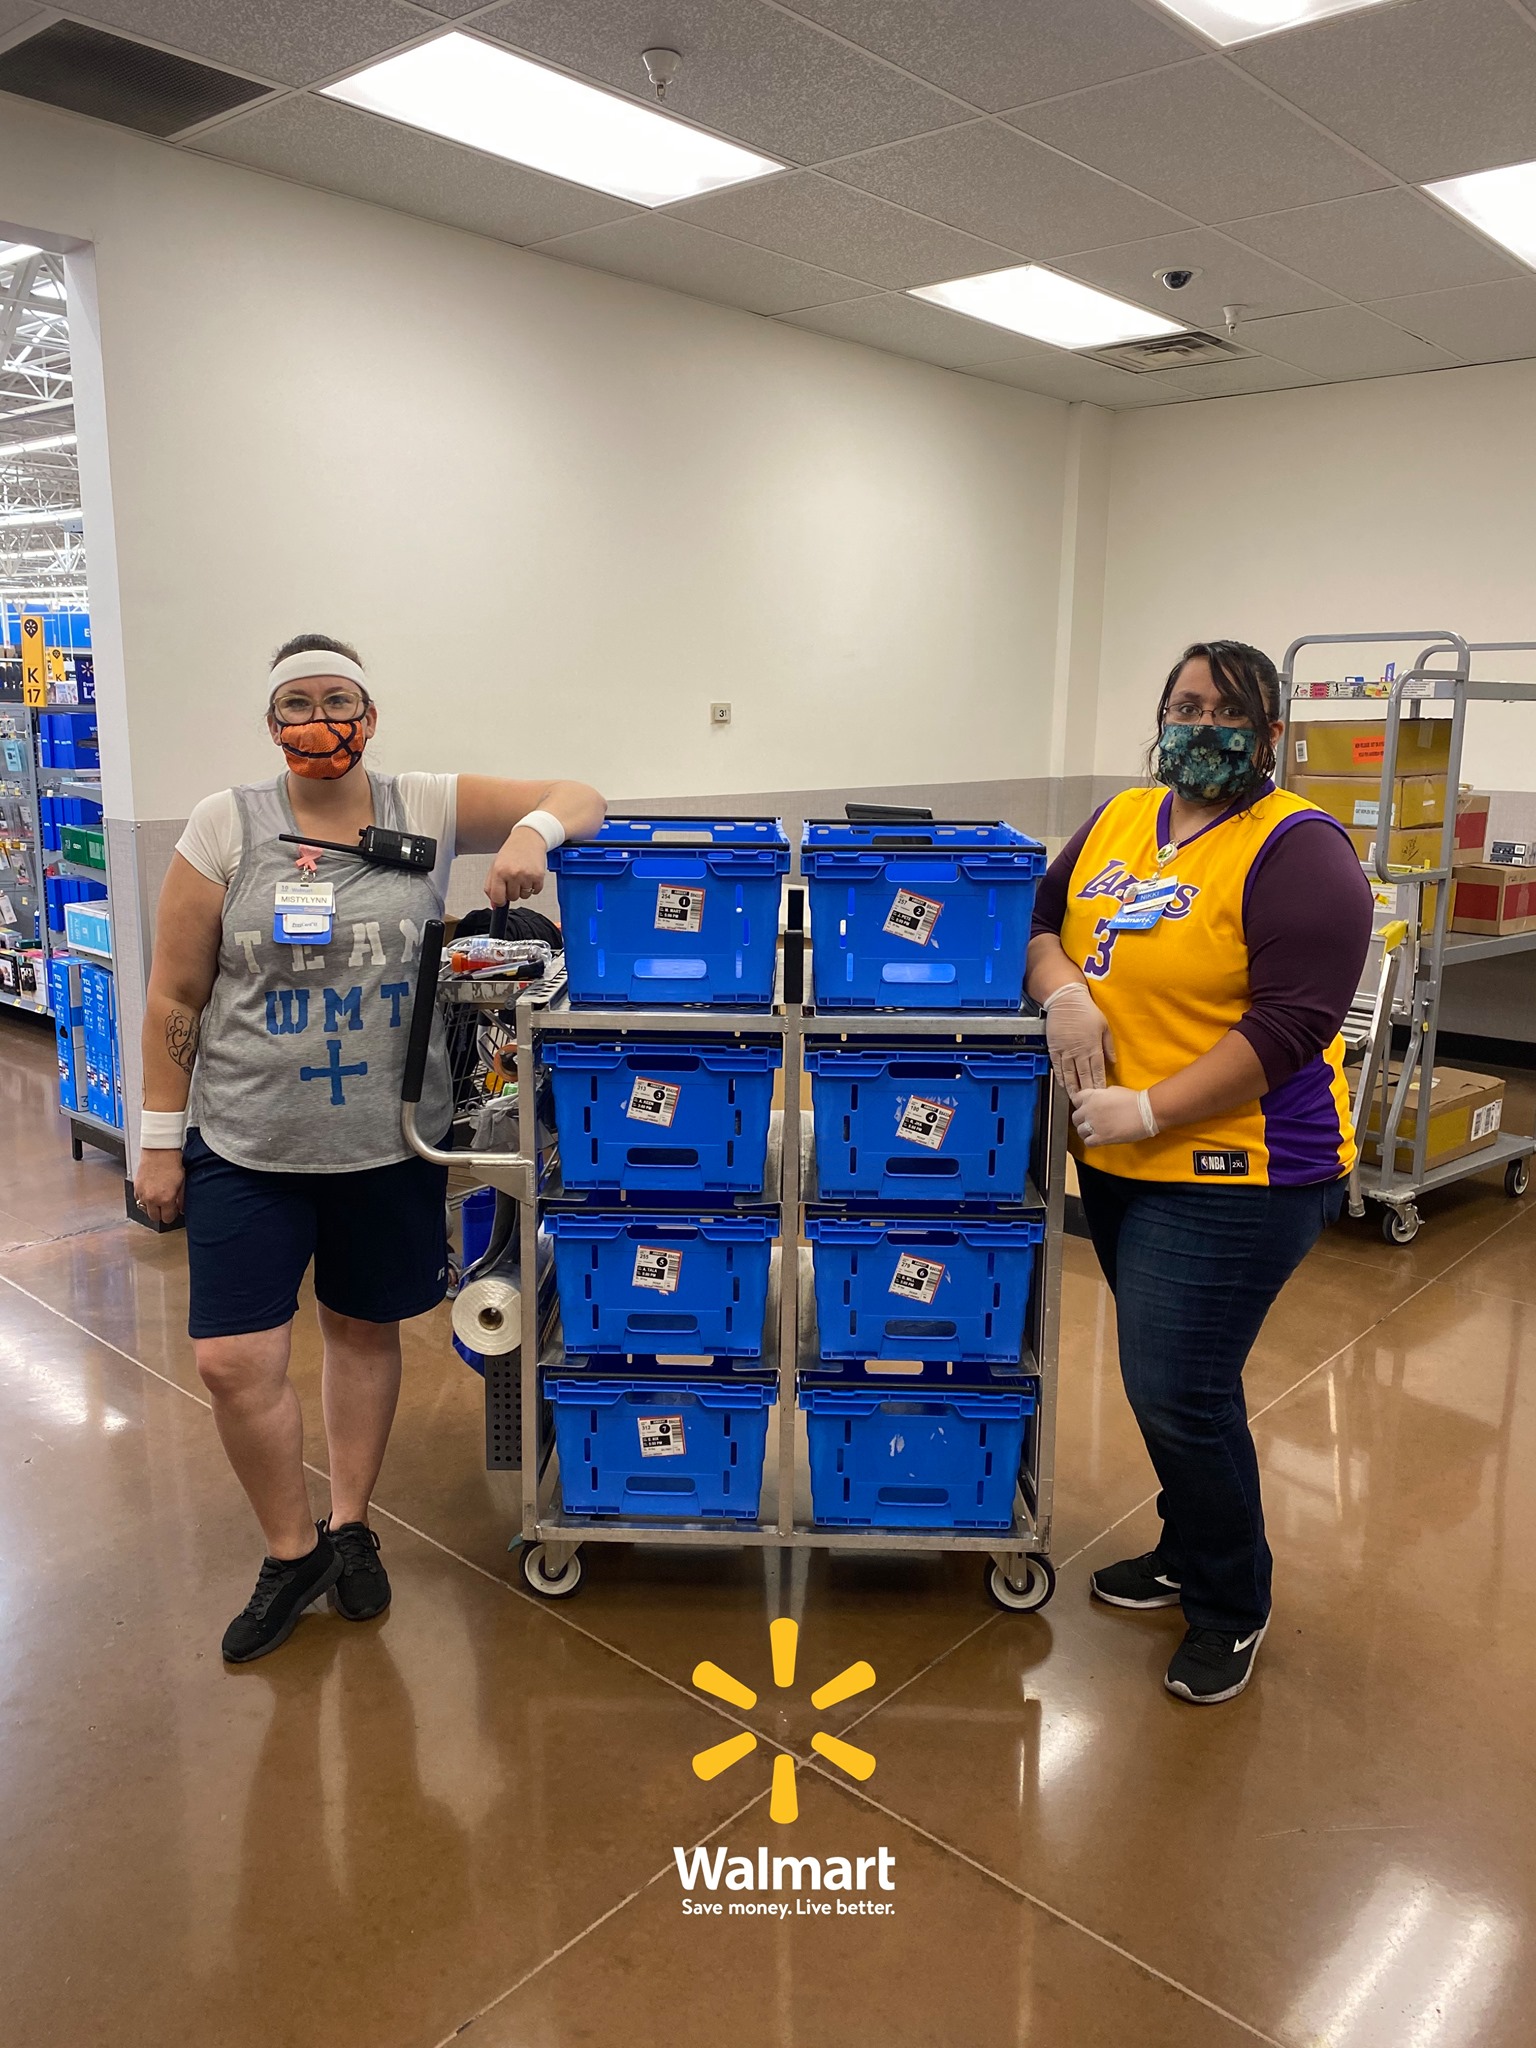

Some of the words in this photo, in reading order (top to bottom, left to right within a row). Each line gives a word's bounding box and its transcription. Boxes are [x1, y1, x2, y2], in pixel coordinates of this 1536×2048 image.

[27, 668, 39, 683] K
[27, 689, 41, 703] 17
[1140, 891, 1160, 900] NIKKI
[264, 982, 409, 1035] WMT
[81, 1096, 89, 1108] 3
[1209, 1156, 1225, 1170] NBA
